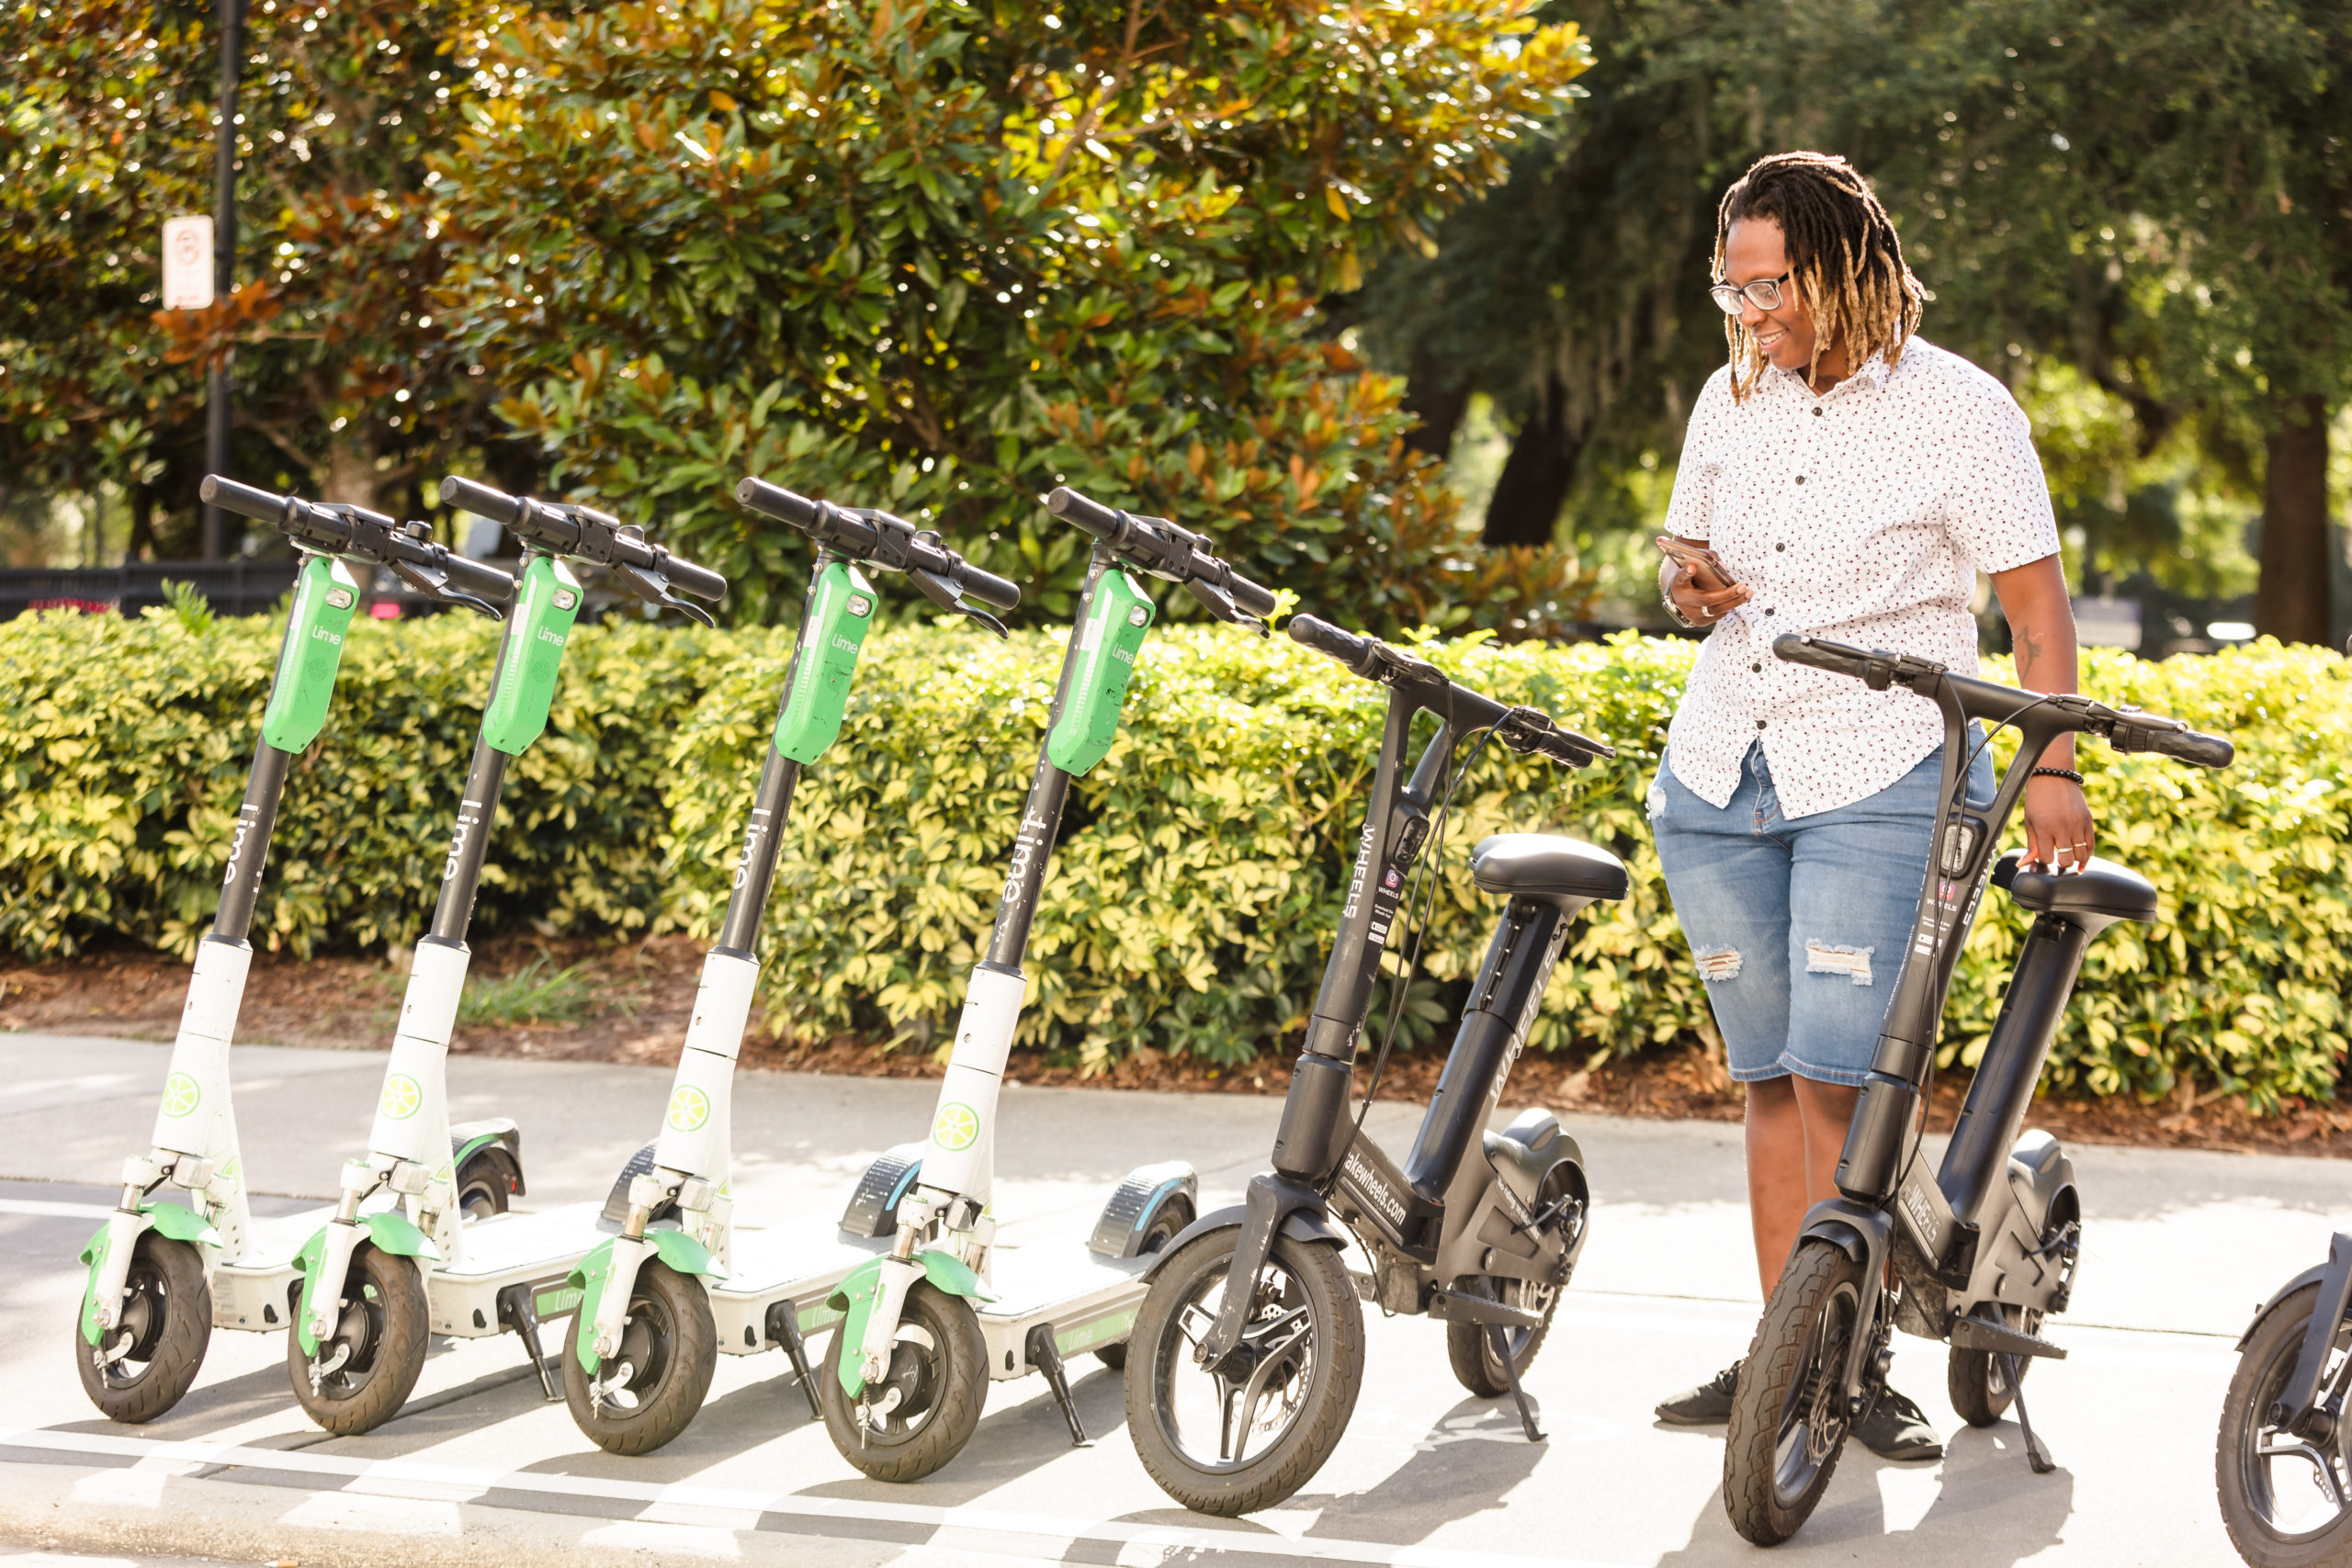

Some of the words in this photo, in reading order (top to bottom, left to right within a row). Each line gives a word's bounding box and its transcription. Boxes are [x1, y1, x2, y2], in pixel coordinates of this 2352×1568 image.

[537, 626, 564, 647] Lime
[831, 633, 858, 654] Lime
[1112, 643, 1135, 665] Lime
[1342, 823, 1375, 919] WHEELS
[1378, 886, 1400, 899] WHEELS
[1927, 897, 1958, 912] WELS
[1345, 1152, 1407, 1226] akewheels.com
